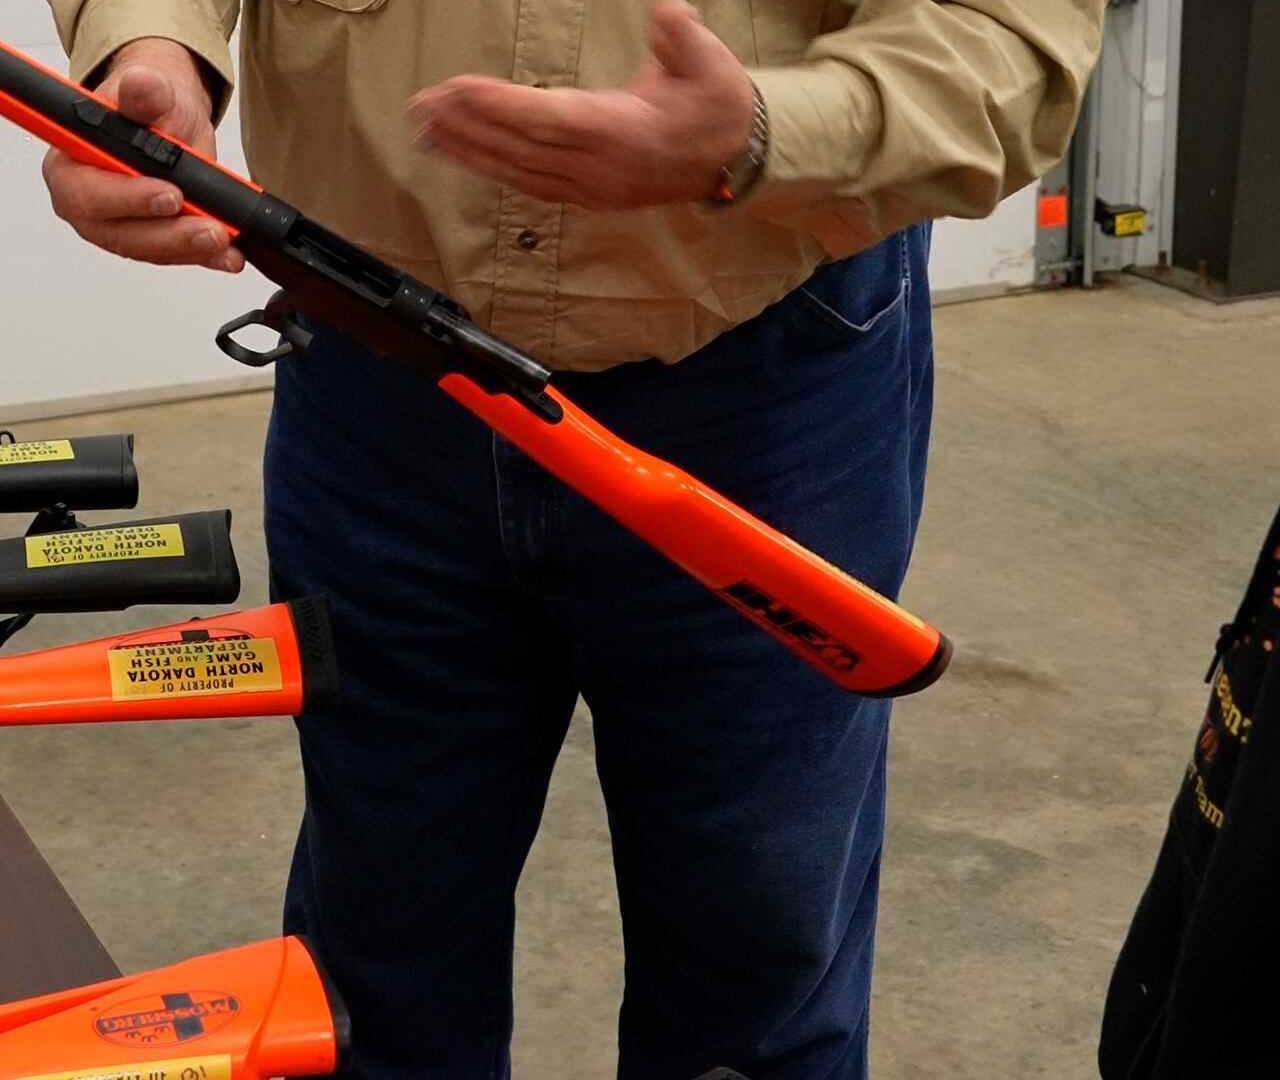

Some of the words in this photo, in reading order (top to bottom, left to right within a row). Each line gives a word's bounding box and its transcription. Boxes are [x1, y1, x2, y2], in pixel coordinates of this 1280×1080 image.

[10, 449, 58, 457] NORTH
[50, 526, 155, 540] DEPARTMENT
[116, 532, 161, 542] GAME
[46, 539, 82, 547] FISH
[115, 540, 167, 549] NORTH
[42, 544, 104, 555] DAKOTA
[89, 550, 139, 559] PROPERTY
[135, 641, 248, 657] DEPARTMENT
[177, 655, 199, 663] AND
[206, 651, 256, 663] GAME
[131, 658, 170, 668] FISH
[127, 667, 195, 682] DAKOTA
[206, 662, 264, 677] NORTH
[160, 684, 174, 693] OF
[180, 678, 234, 691] PROPERTY
